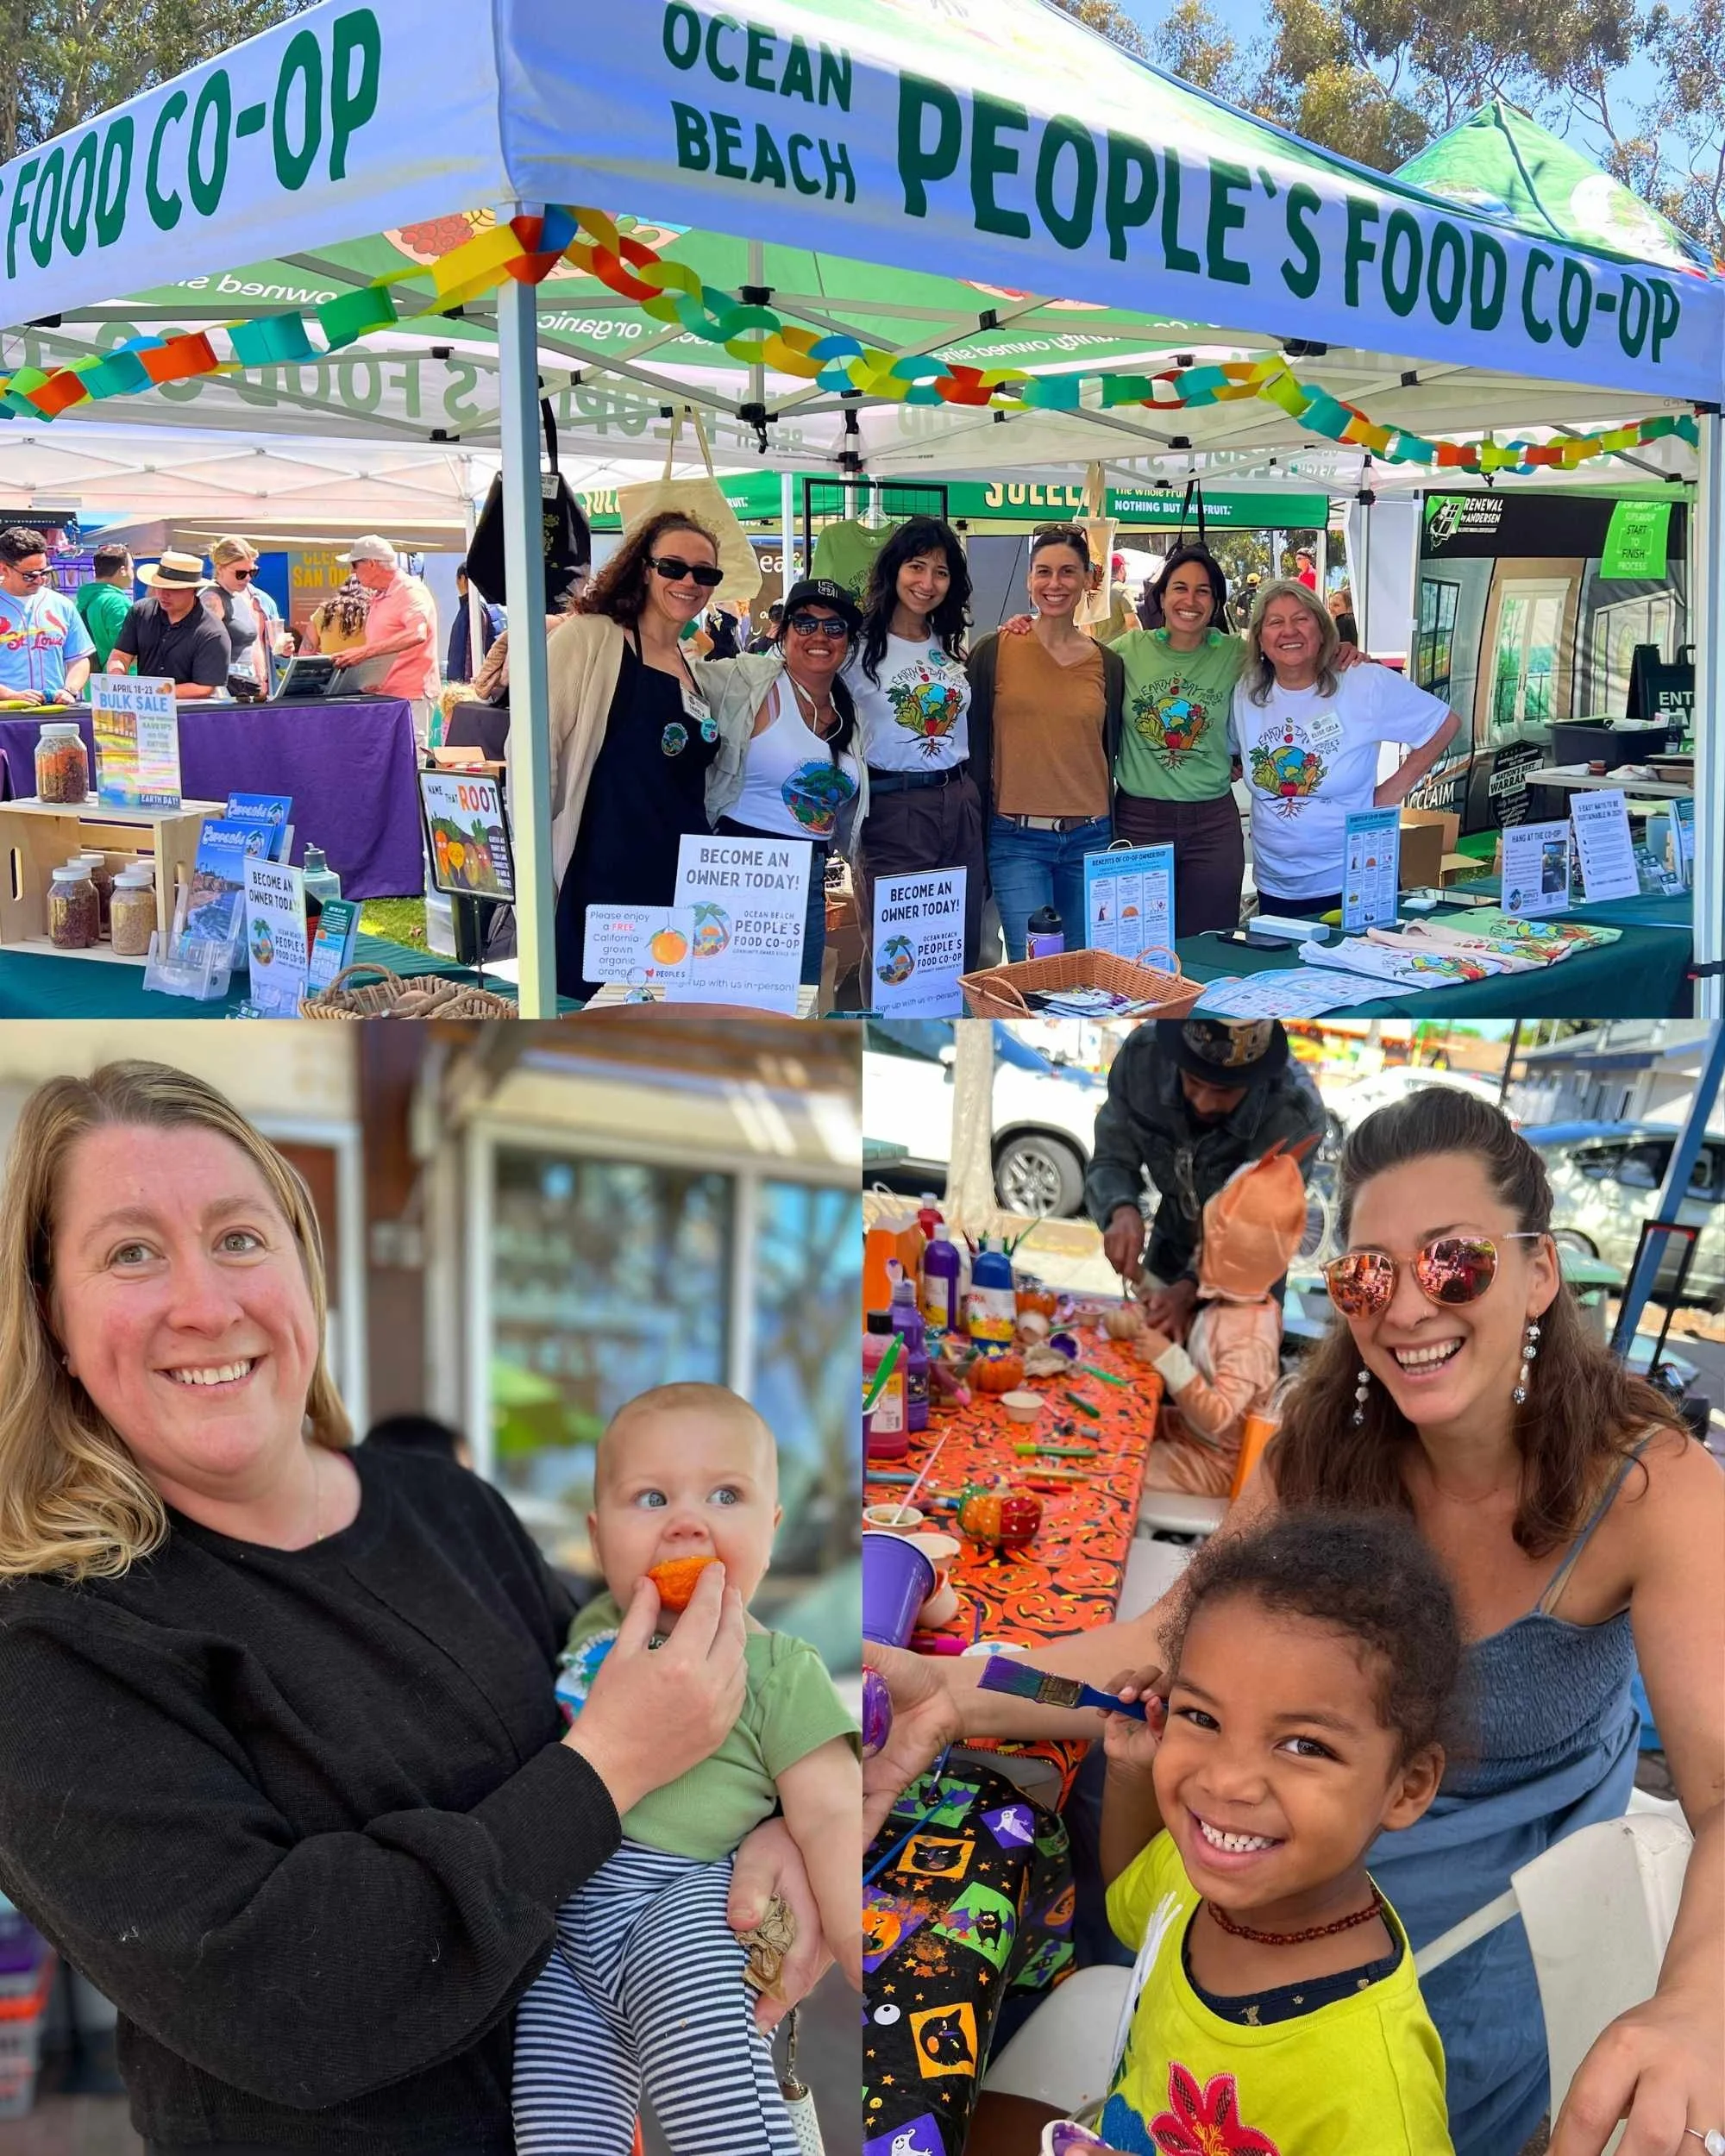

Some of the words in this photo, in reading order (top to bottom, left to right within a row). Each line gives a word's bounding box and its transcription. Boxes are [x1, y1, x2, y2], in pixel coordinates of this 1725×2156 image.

[662, 0, 852, 112] OCEAN
[7, 116, 134, 279] FOOD
[145, 8, 381, 231] CO-OP
[670, 100, 856, 204] BEACH
[898, 69, 1321, 300] PEOPLE'S
[1345, 195, 1508, 331] FOOD
[1521, 248, 1680, 364] CO-OP
[1114, 499, 1160, 512] NOTHING
[1163, 502, 1181, 513] BUT
[1463, 498, 1504, 511] RENEWAL
[1631, 537, 1640, 547] TO
[1622, 548, 1645, 559] FINISH
[293, 565, 323, 588] SAN
[112, 684, 132, 693] APRIL
[100, 693, 131, 710] BULK
[136, 696, 168, 712] SALE
[428, 785, 442, 794] NAME
[1490, 774, 1525, 794] WARRAN
[457, 785, 498, 813] ROOT
[700, 848, 763, 867] BECOME
[768, 852, 789, 868] AN
[253, 871, 282, 891] BECOME
[283, 879, 294, 893] AN
[687, 869, 741, 887] OWNER
[744, 873, 800, 891] TODAY!
[248, 889, 273, 906] OWNER
[890, 883, 935, 903] BECOME
[938, 881, 952, 896] AN
[590, 911, 622, 920] Please
[624, 912, 650, 923] enjoy
[744, 910, 768, 918] OCEAN
[770, 912, 795, 920] BEACH
[881, 905, 919, 923] OWNER
[922, 899, 959, 918] TODAY!
[735, 919, 800, 936] PEOPLE'S
[602, 946, 633, 955] grown
[734, 936, 762, 947] FOOD
[765, 937, 800, 950] CO-OP
[918, 938, 963, 956] PEOPLE'S
[599, 957, 636, 967] organic
[917, 956, 938, 968] FOOD
[938, 952, 963, 964] CO-OP
[693, 979, 706, 987] up
[708, 979, 727, 989] with
[731, 981, 743, 989] us
